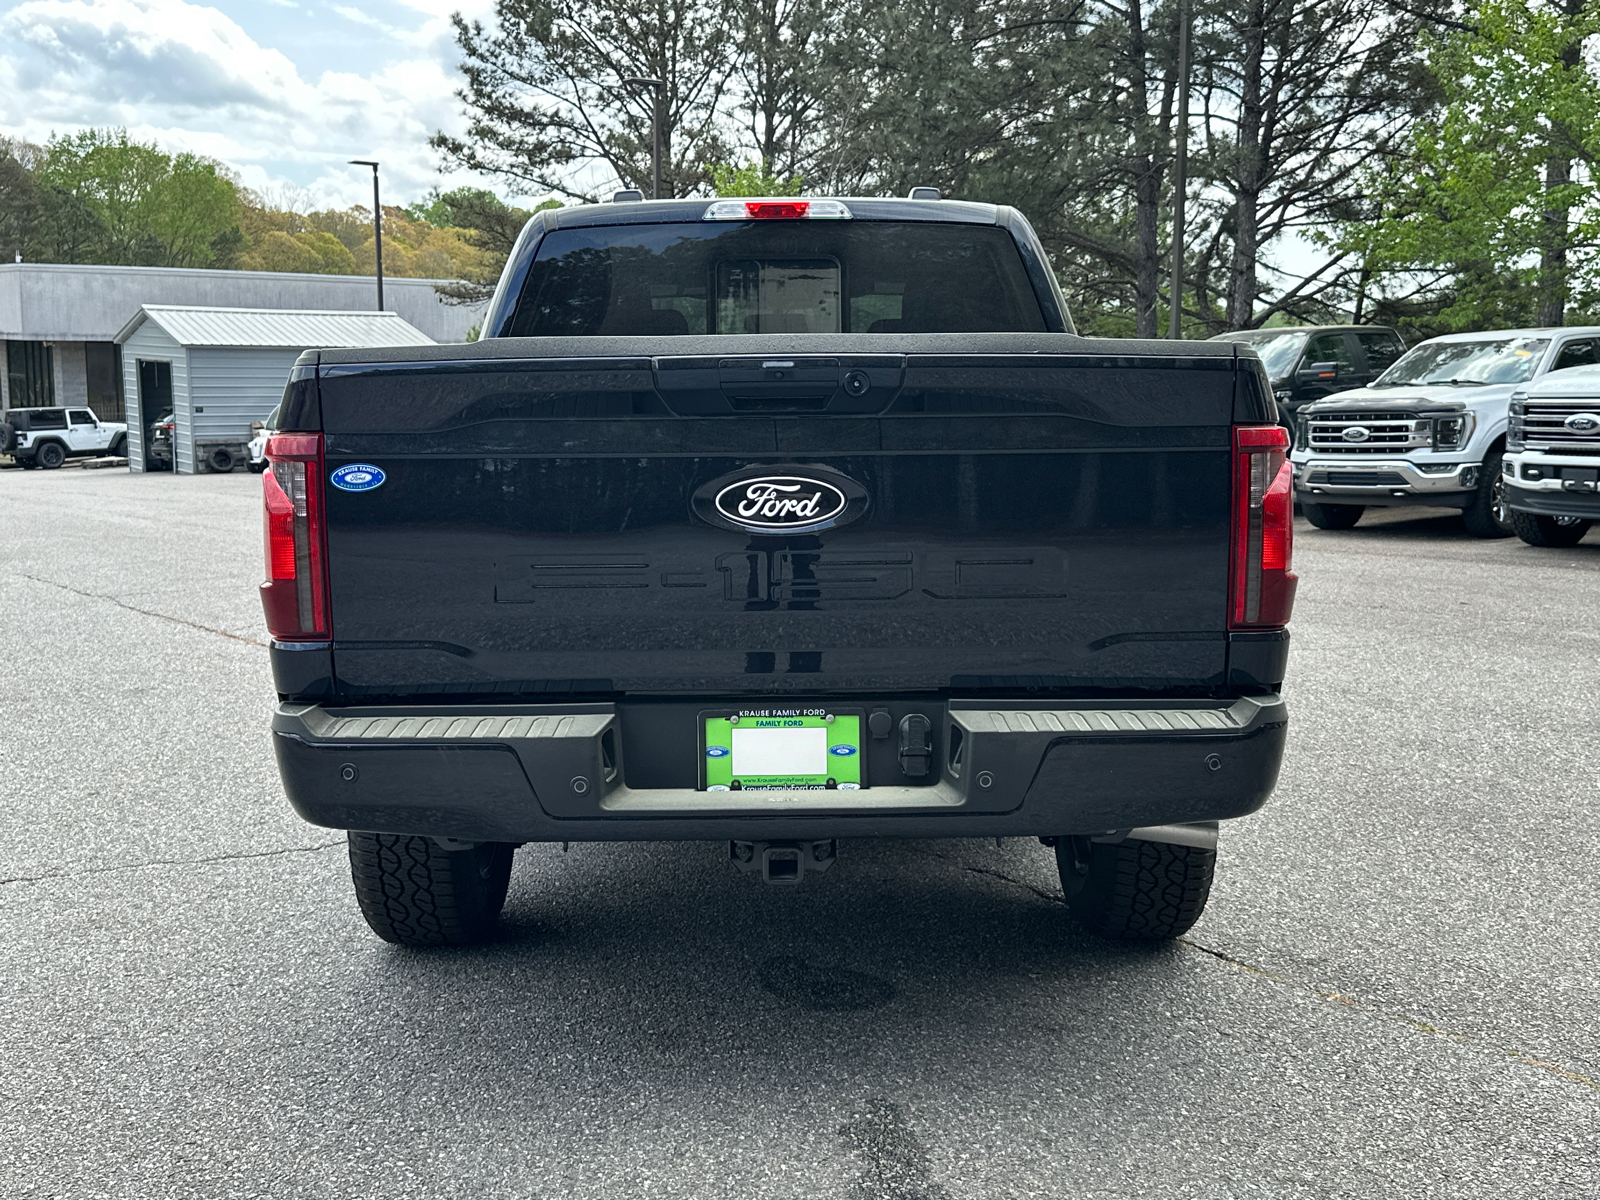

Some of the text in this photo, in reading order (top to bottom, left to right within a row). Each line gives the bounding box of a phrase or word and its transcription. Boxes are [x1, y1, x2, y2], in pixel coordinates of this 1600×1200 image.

[738, 483, 822, 517] Ford
[739, 709, 770, 717] KRAUSE
[803, 708, 826, 716] FORD
[783, 719, 804, 727] FORD
